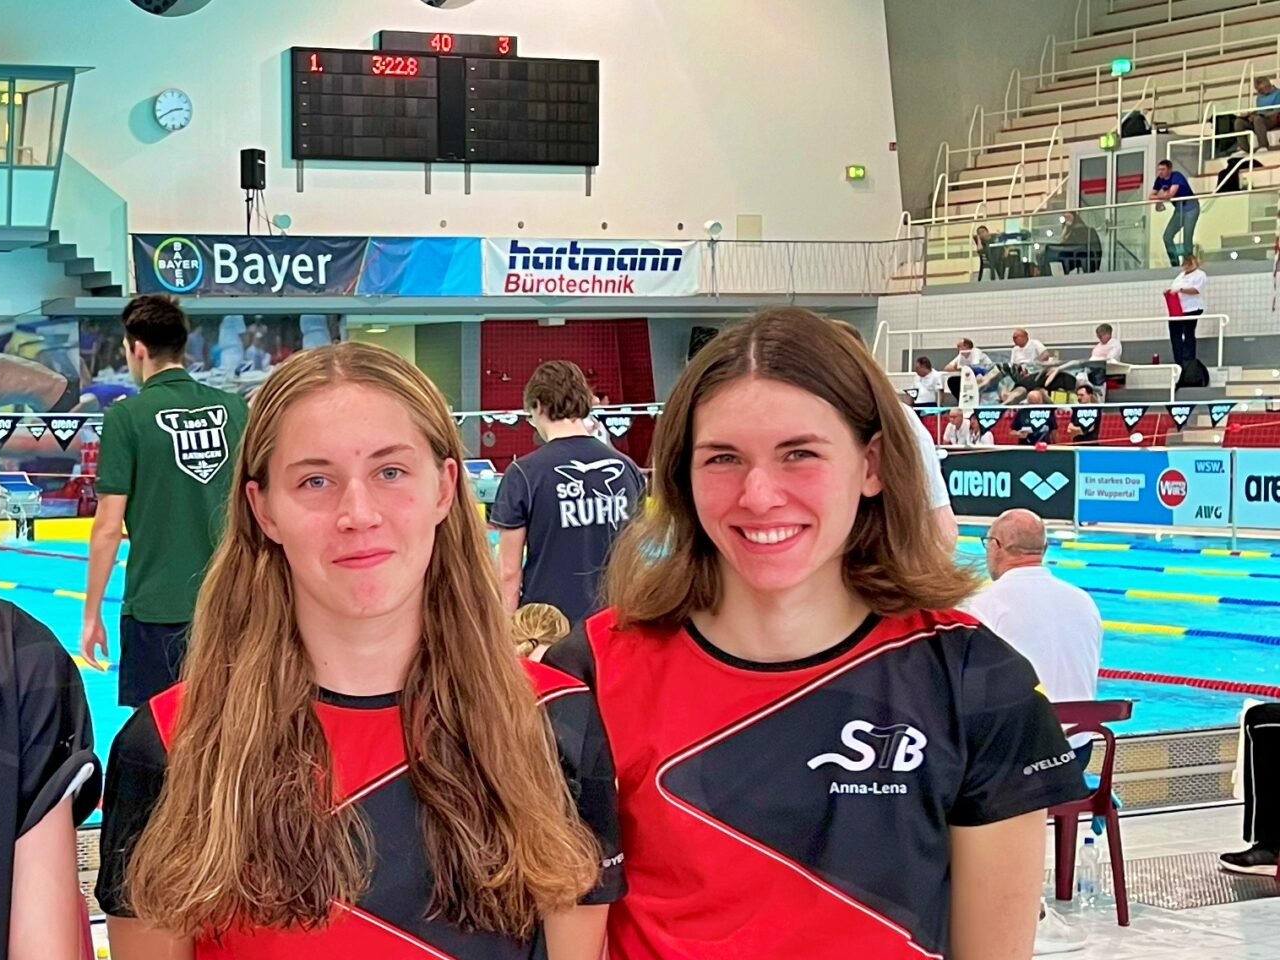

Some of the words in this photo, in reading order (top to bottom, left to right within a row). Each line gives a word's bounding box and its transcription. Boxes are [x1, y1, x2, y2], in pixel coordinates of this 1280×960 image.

[431, 34, 455, 52] 40
[498, 36, 510, 54] 3
[158, 260, 199, 269] BAYER
[509, 240, 683, 271] hartmann
[213, 243, 332, 293] Bayer
[504, 273, 634, 293] Bürotechnik
[51, 419, 80, 429] arena
[556, 483, 582, 499] SG
[949, 470, 1012, 498] arena
[559, 496, 629, 528] RUHR
[829, 781, 908, 795] Anna-Lena
